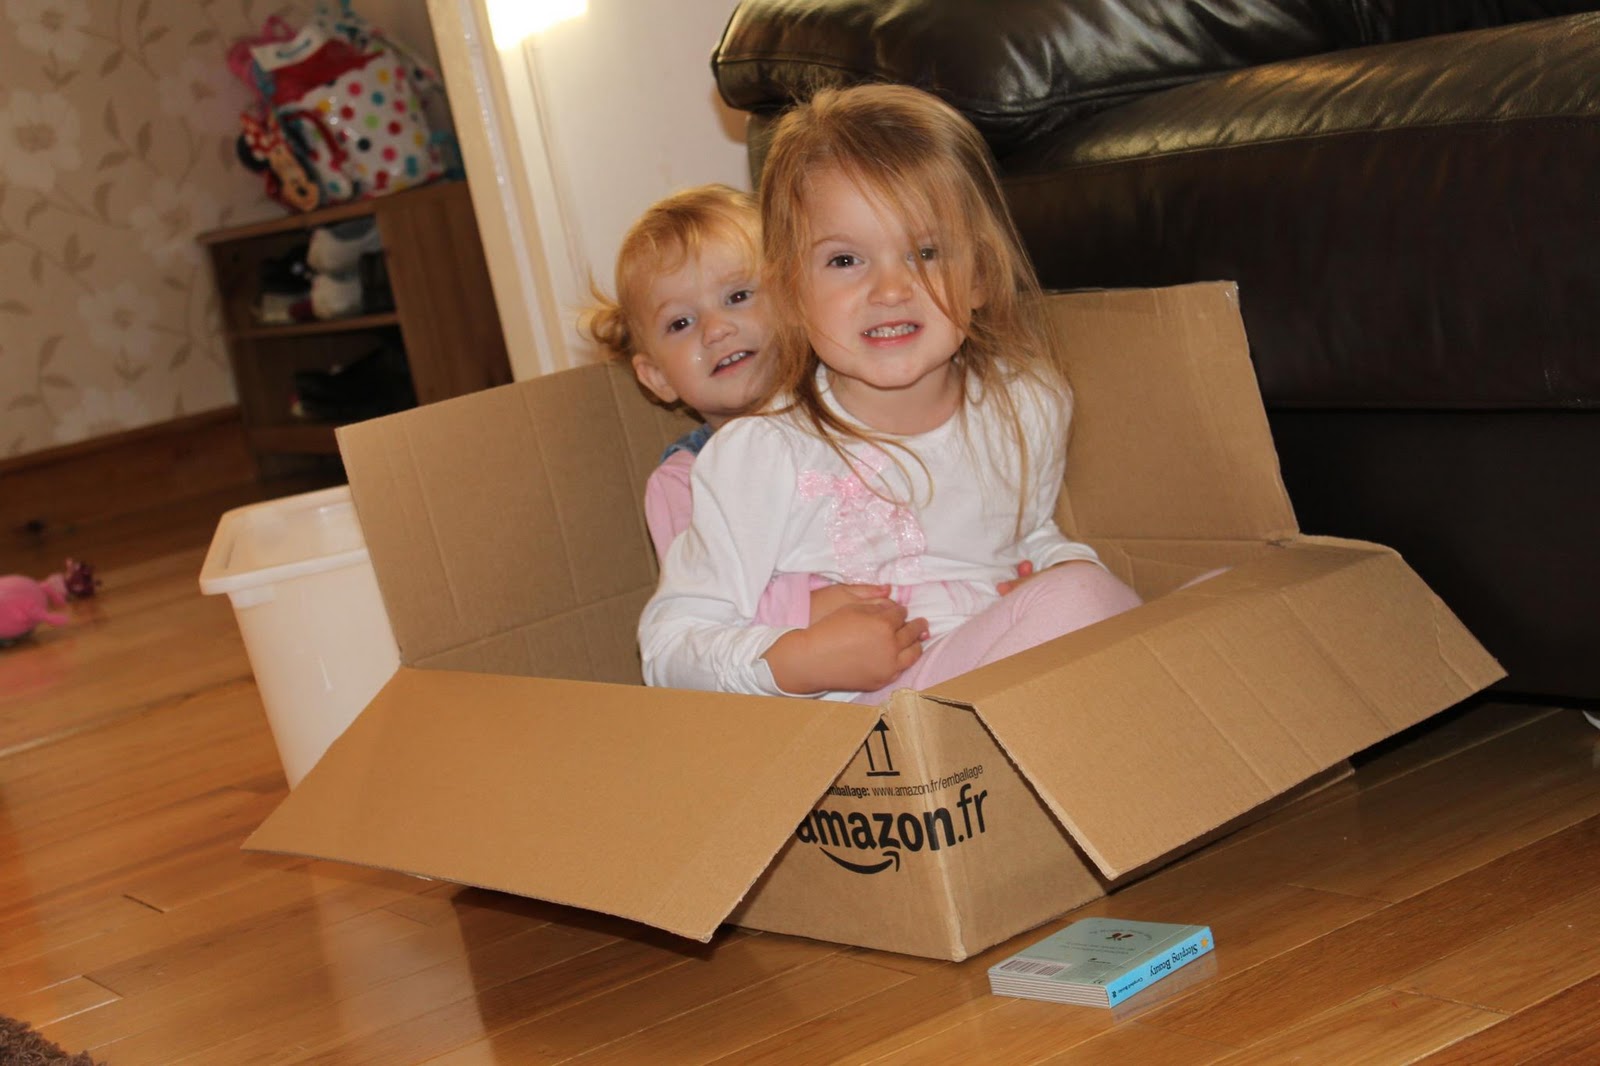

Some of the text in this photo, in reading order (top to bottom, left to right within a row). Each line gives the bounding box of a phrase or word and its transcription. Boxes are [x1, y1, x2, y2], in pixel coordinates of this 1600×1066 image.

[872, 764, 984, 797] www.amazon.fr/emballage
[796, 783, 988, 852] amazon.fr
[1150, 944, 1199, 977] Sleeping Beauty
